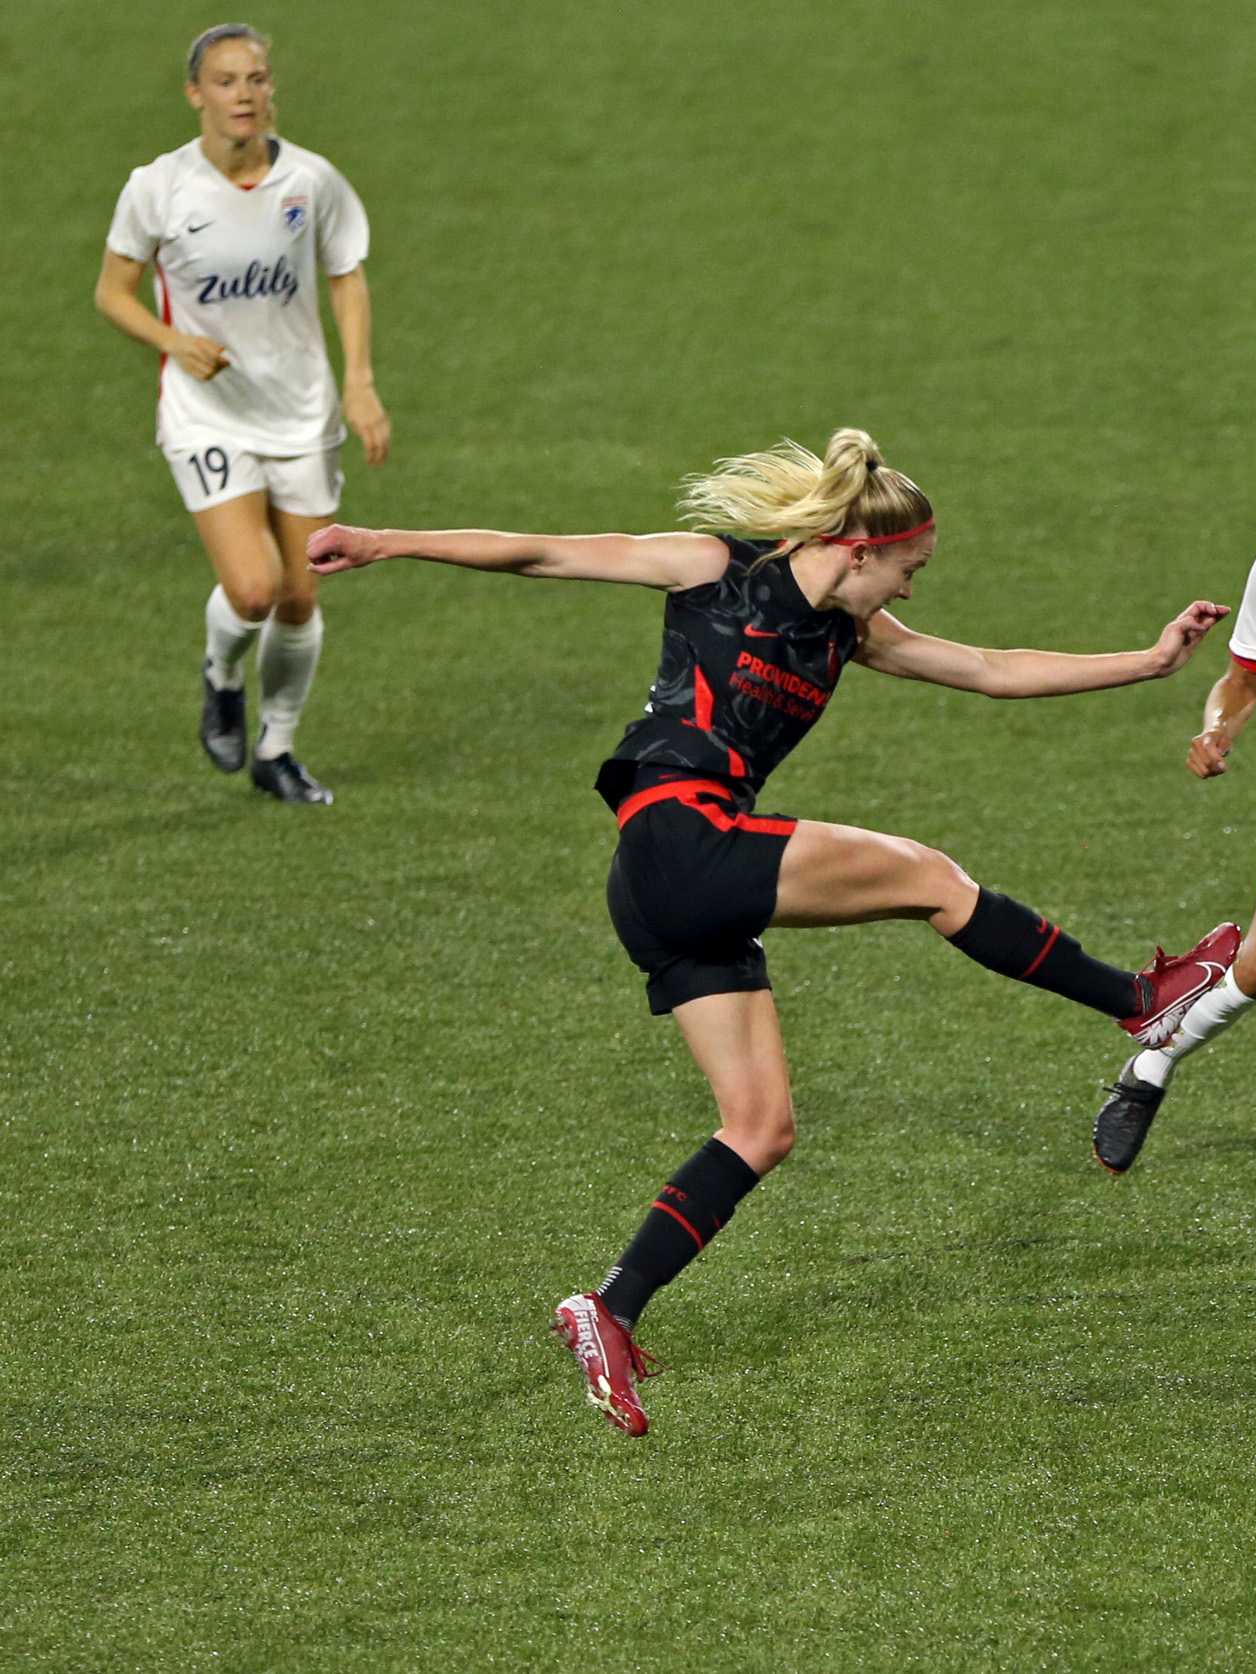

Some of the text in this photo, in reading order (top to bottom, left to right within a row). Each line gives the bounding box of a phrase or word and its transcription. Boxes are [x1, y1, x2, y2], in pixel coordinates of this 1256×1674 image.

[189, 446, 229, 496] 19
[736, 650, 832, 707] PROVIDEN
[574, 1311, 599, 1359] FIERCE
